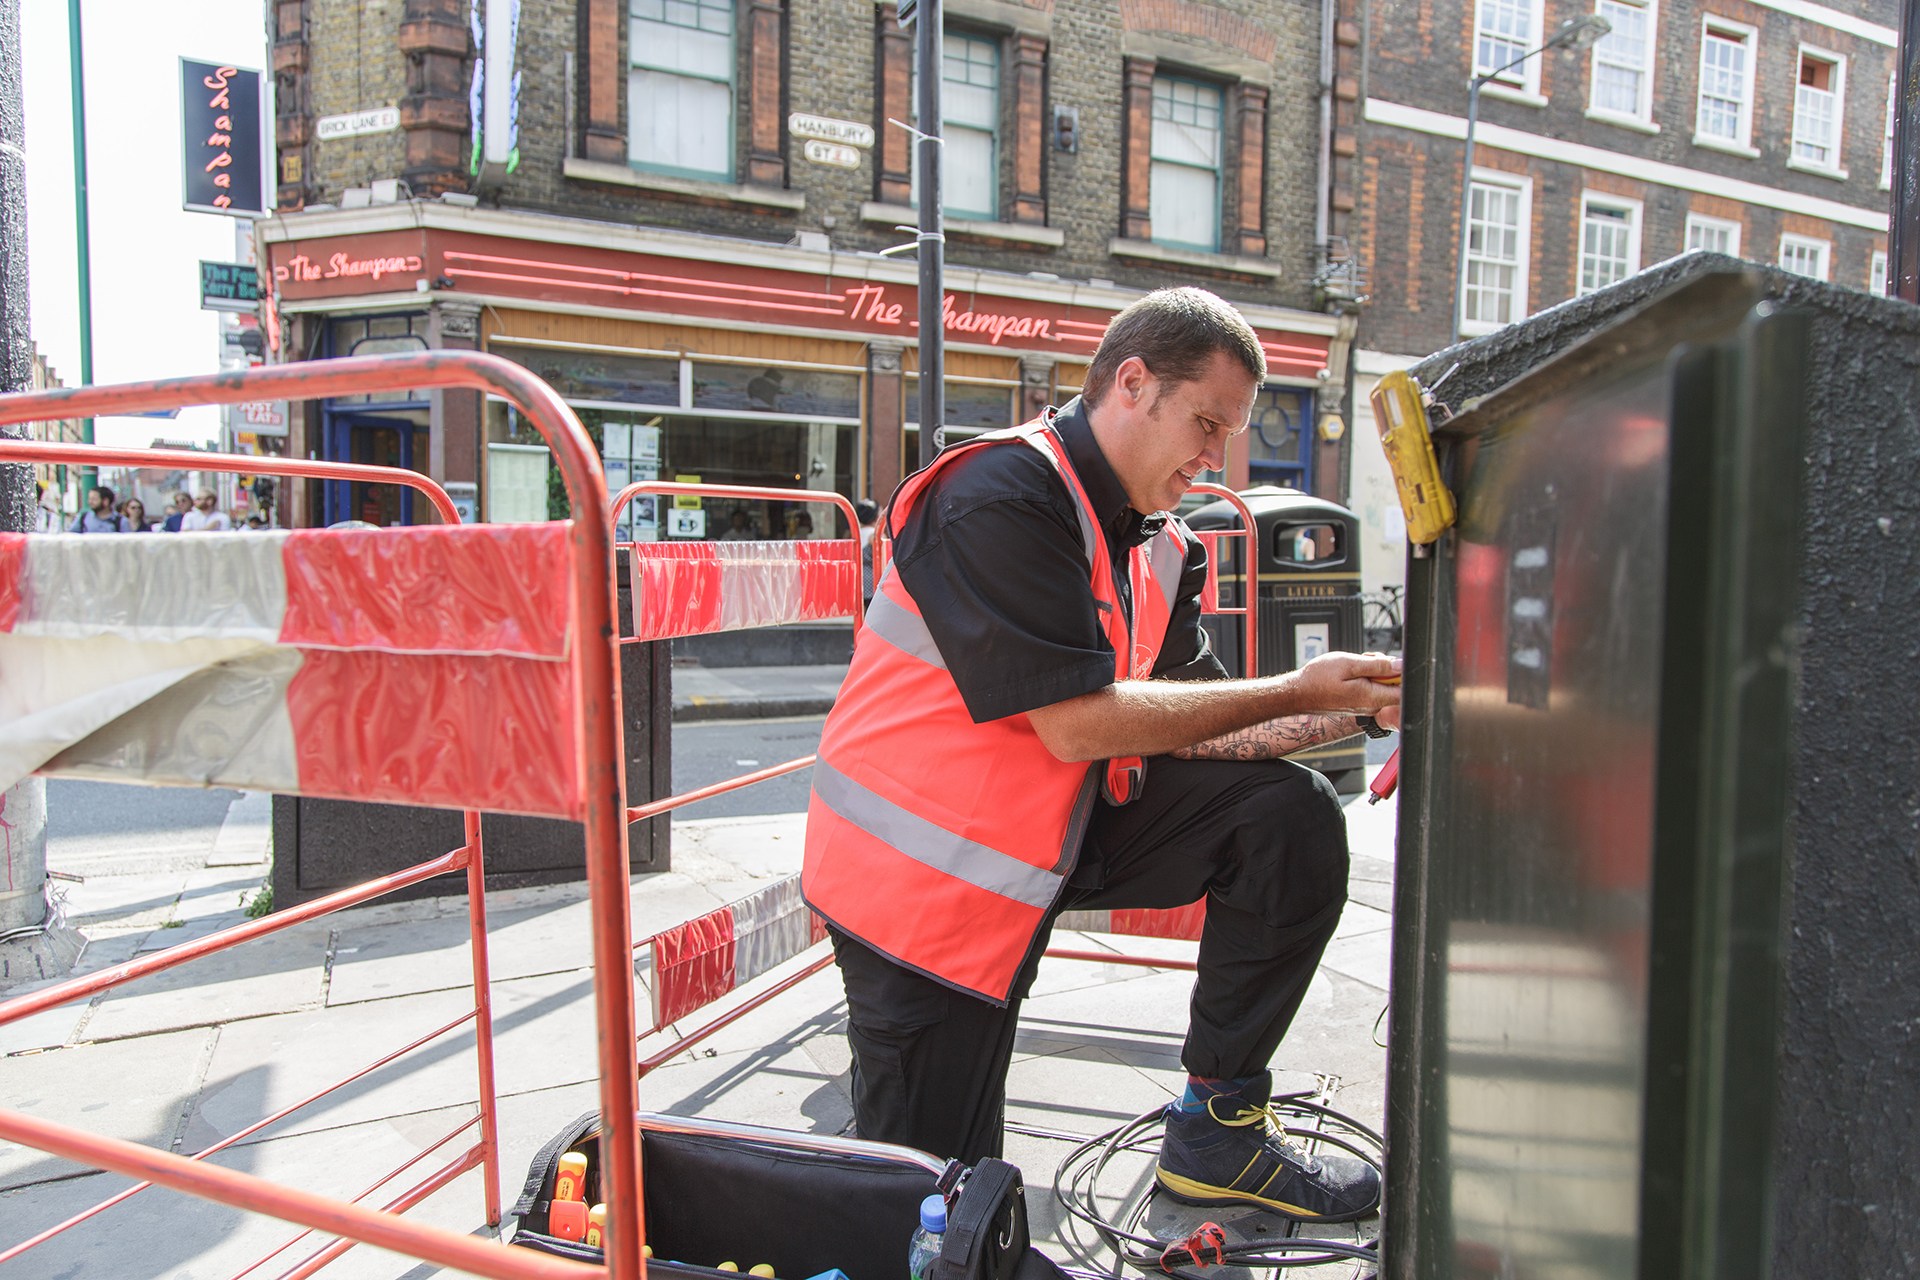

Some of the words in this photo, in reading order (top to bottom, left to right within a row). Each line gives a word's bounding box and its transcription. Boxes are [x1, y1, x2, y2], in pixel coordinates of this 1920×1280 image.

[320, 119, 348, 135] BRICK
[352, 114, 379, 130] LANE
[796, 119, 867, 140] HANBURY
[203, 66, 238, 209] Shampan
[289, 255, 321, 281] The
[324, 252, 407, 280] Shampan
[846, 285, 903, 325] The
[909, 294, 1050, 345] hampan
[1287, 585, 1335, 598] LITTER
